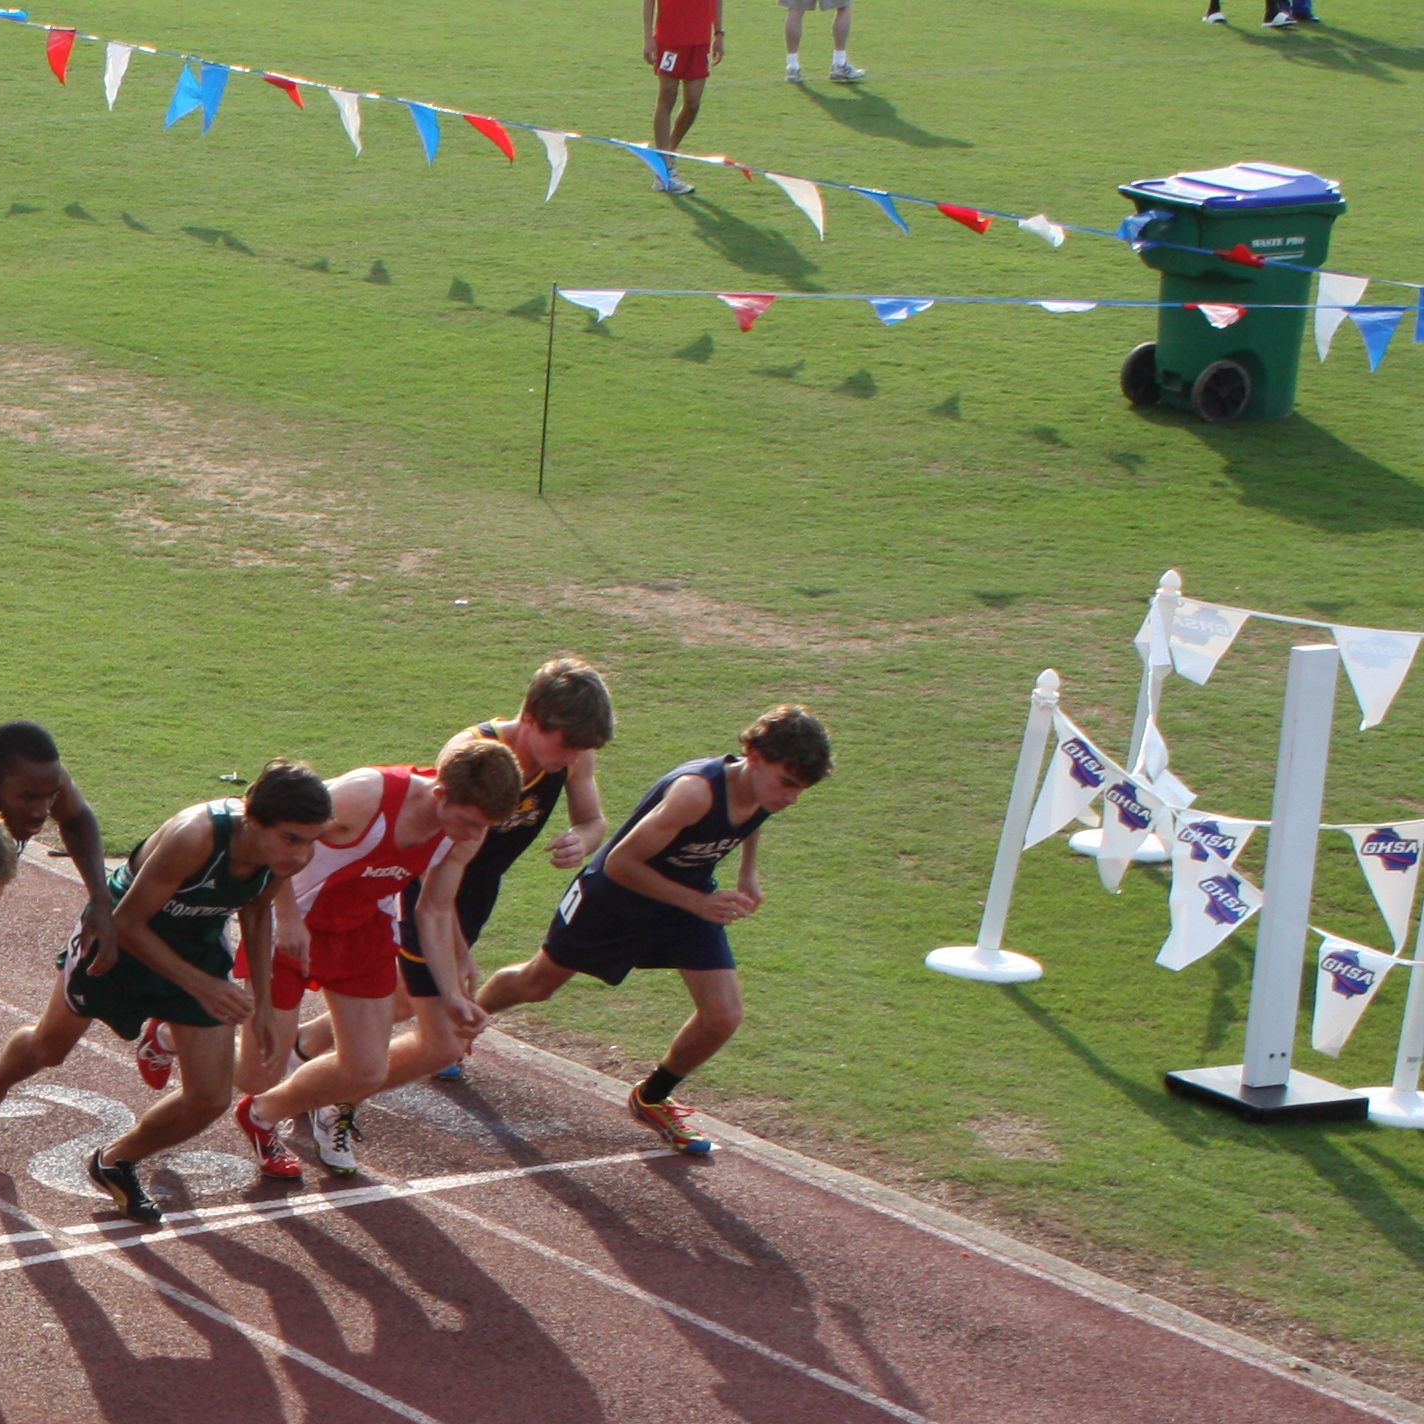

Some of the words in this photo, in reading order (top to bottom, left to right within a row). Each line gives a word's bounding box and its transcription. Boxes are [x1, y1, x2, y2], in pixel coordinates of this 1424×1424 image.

[1106, 787, 1151, 823] GHSA
[1361, 839, 1420, 856] GHSA
[1199, 877, 1250, 921] GHSA
[1321, 957, 1375, 987] GHSA
